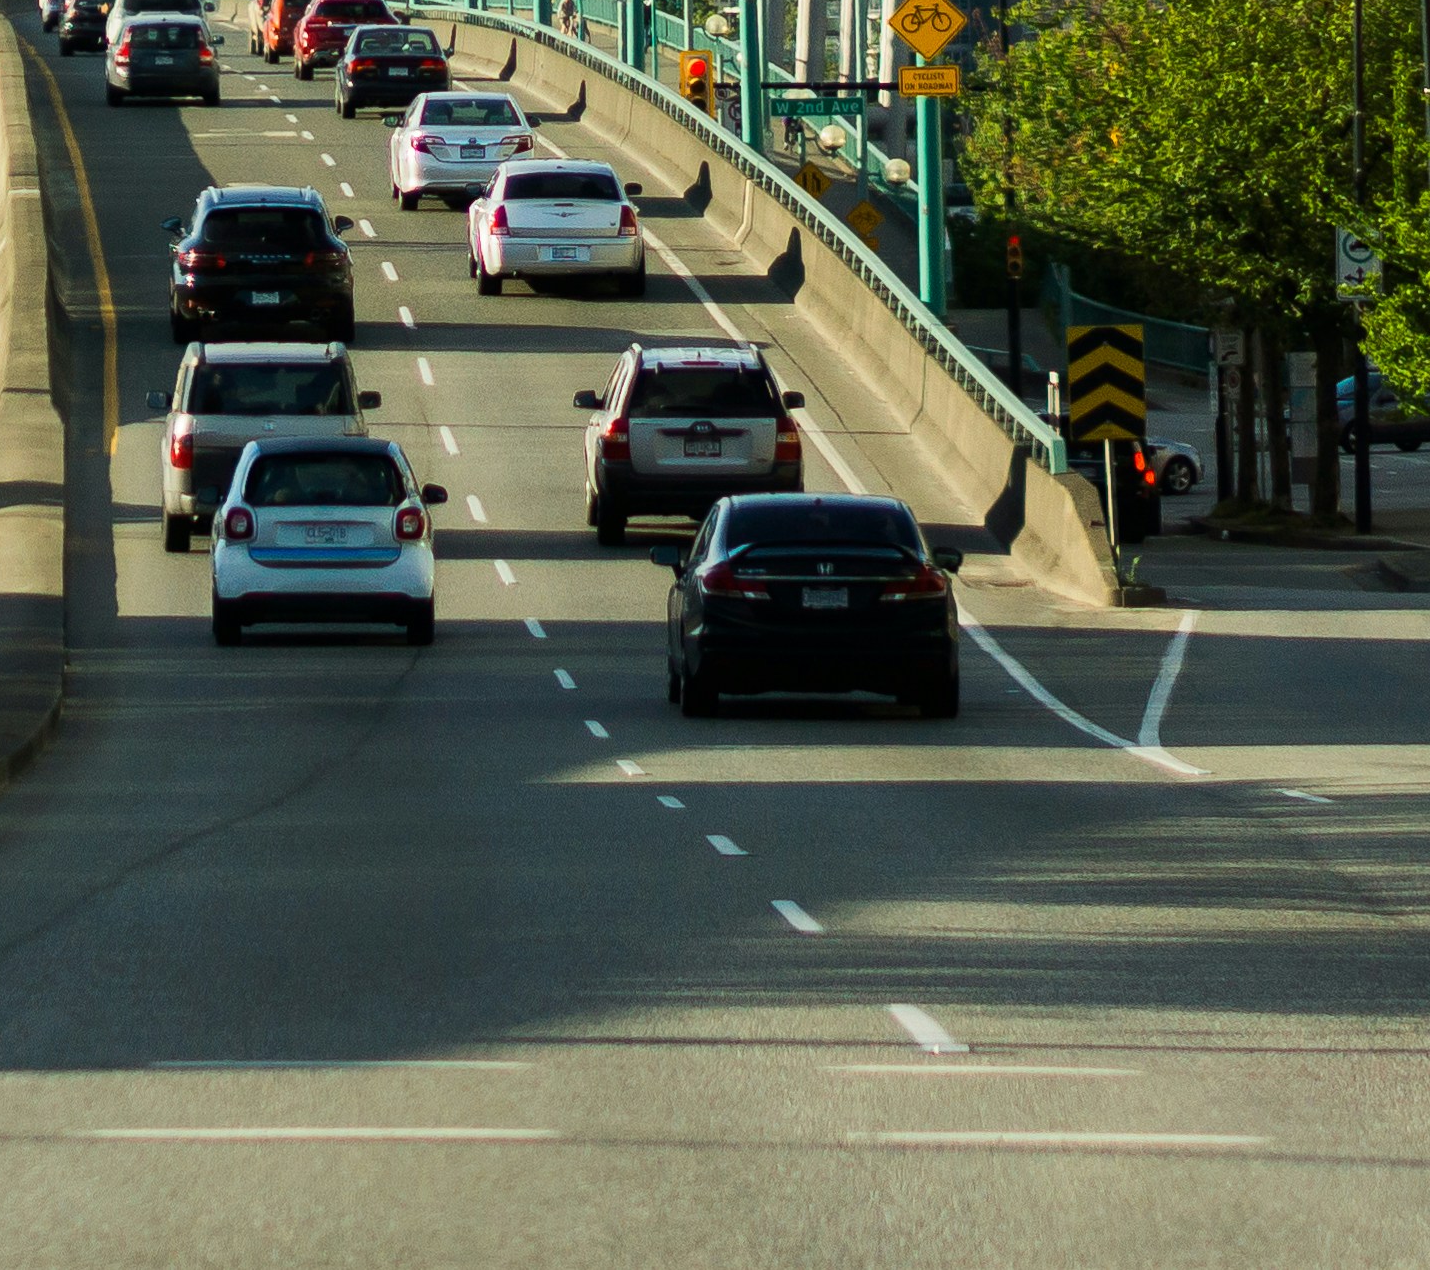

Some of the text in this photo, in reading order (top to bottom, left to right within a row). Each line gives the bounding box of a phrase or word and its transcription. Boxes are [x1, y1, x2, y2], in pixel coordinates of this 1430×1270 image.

[913, 72, 945, 81] CYCLISTS
[904, 82, 953, 91] ON ROADWAY
[776, 100, 859, 114] W 2nd Ave
